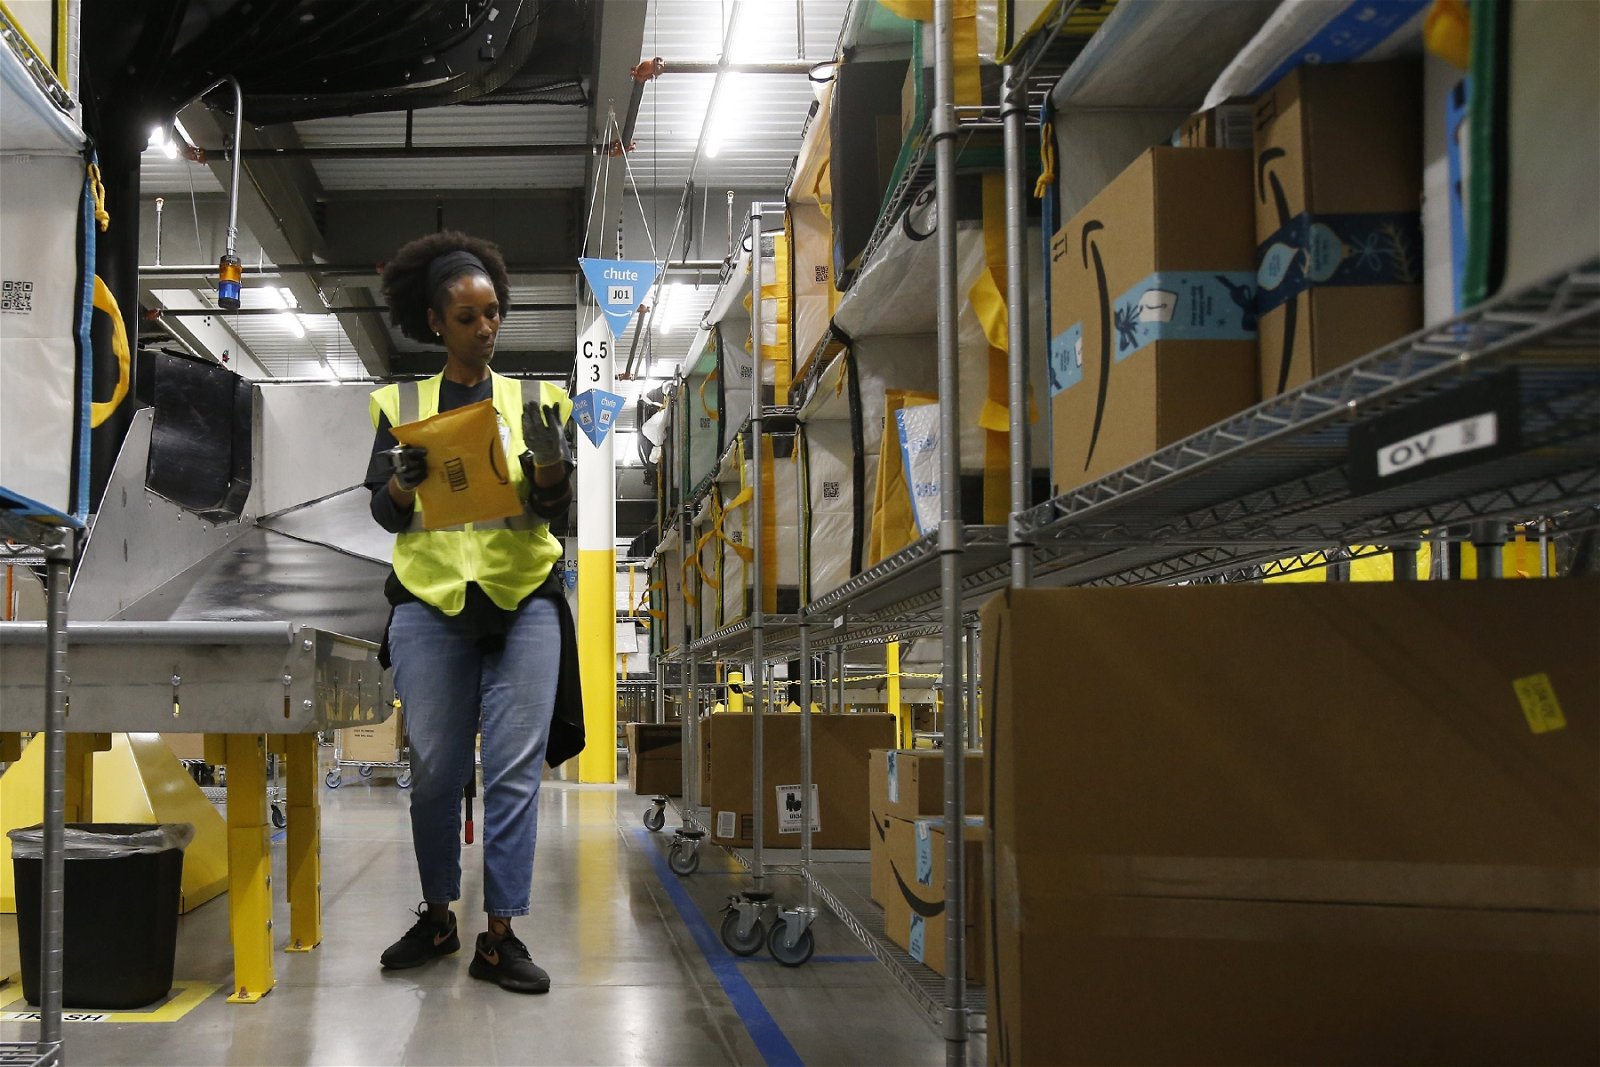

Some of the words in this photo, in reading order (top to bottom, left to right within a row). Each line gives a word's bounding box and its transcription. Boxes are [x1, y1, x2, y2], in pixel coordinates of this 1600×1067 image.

[603, 268, 638, 281] chute
[612, 289, 630, 300] J01
[583, 341, 608, 359] C.5
[590, 364, 601, 382] 3
[601, 397, 616, 408] chute
[1389, 434, 1435, 466] OV
